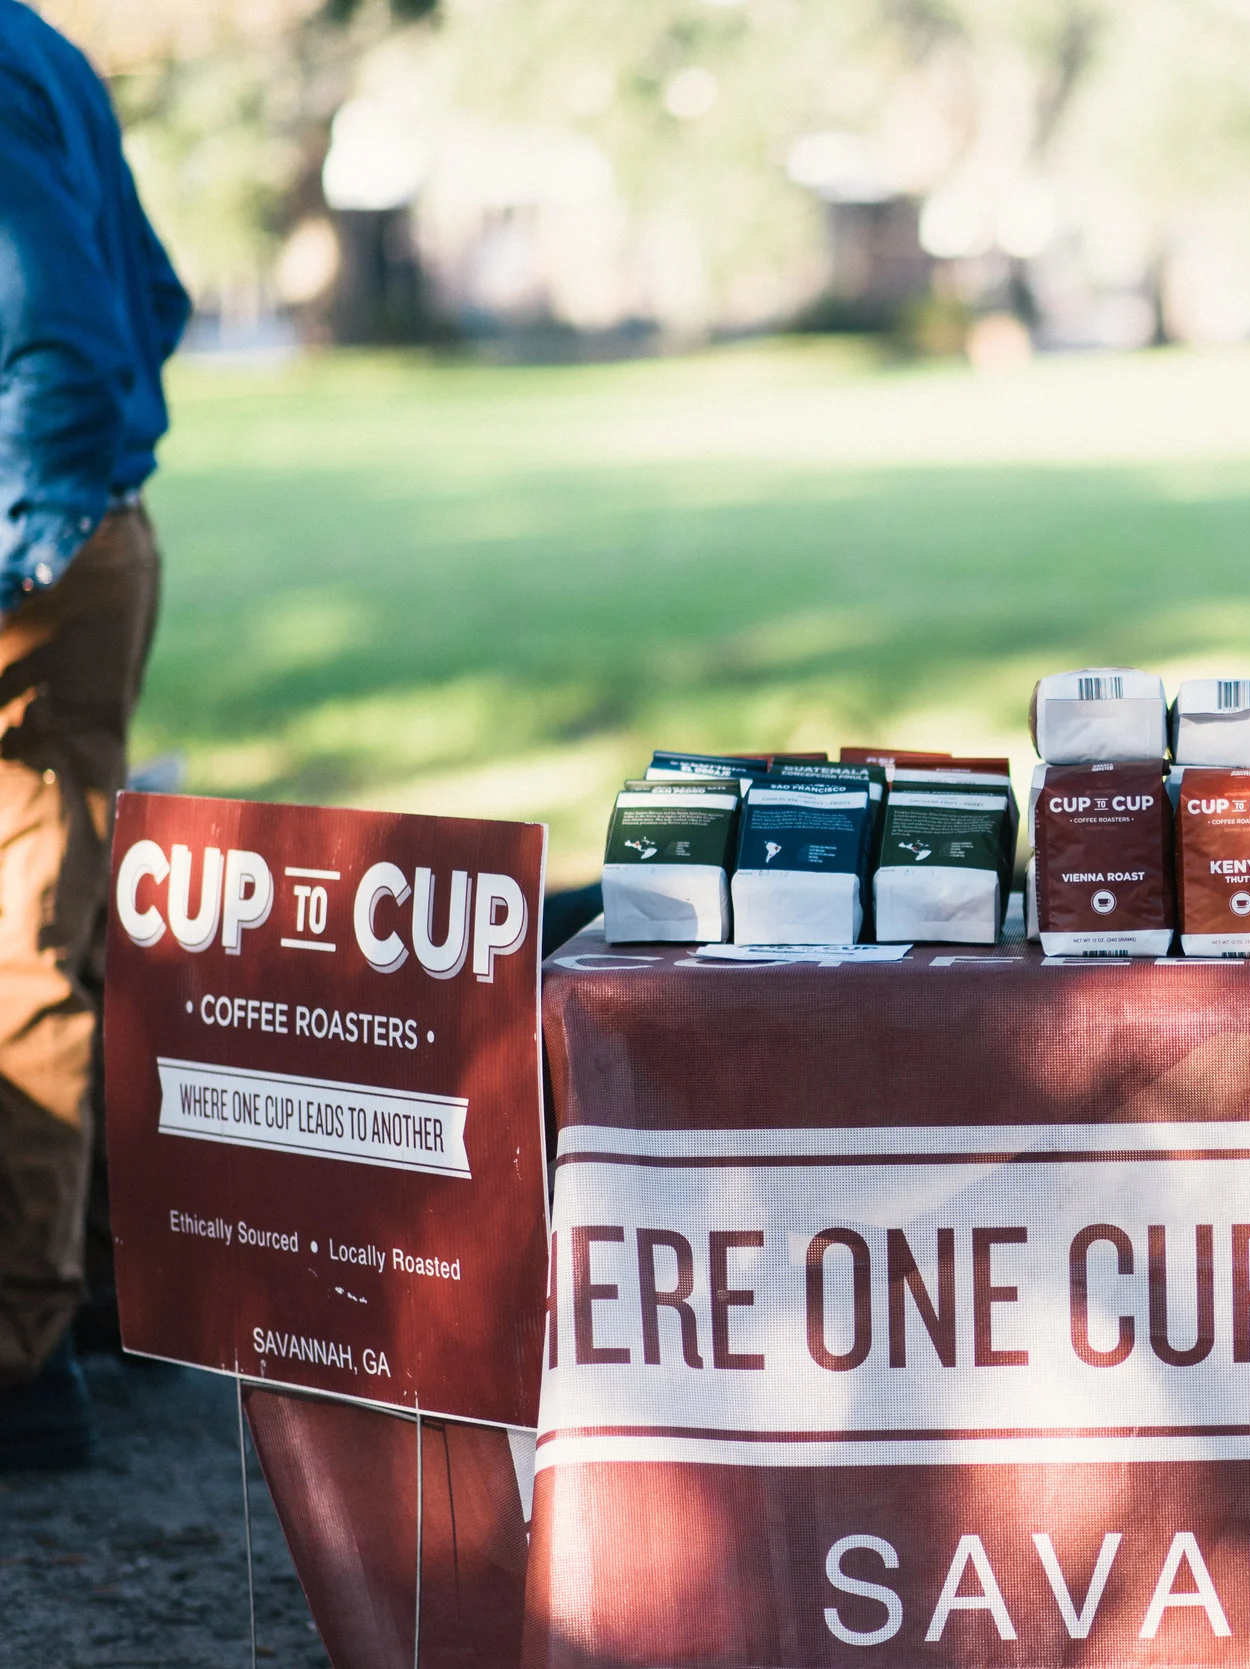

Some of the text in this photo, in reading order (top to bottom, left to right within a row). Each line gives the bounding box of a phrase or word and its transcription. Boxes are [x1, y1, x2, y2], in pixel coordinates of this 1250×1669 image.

[784, 766, 869, 775] GUATEMALA
[792, 786, 846, 794] FRANCISCO
[1049, 797, 1091, 813] CUP
[1112, 796, 1154, 811] CUP
[1187, 798, 1230, 815] CUP
[1062, 872, 1145, 882] VIENNA ROAST
[116, 838, 528, 984] CUP TO CUP
[200, 994, 418, 1050] COFFEE ROASTERS
[179, 1082, 445, 1153] WHERE ONE CUP LEADS TO ANOTHER
[169, 1208, 462, 1281] Ethically Sourced Locally Roasted
[547, 1224, 767, 1372] ERE
[805, 1226, 1029, 1372] ONE
[253, 1327, 391, 1378] SAVANNAH, GA
